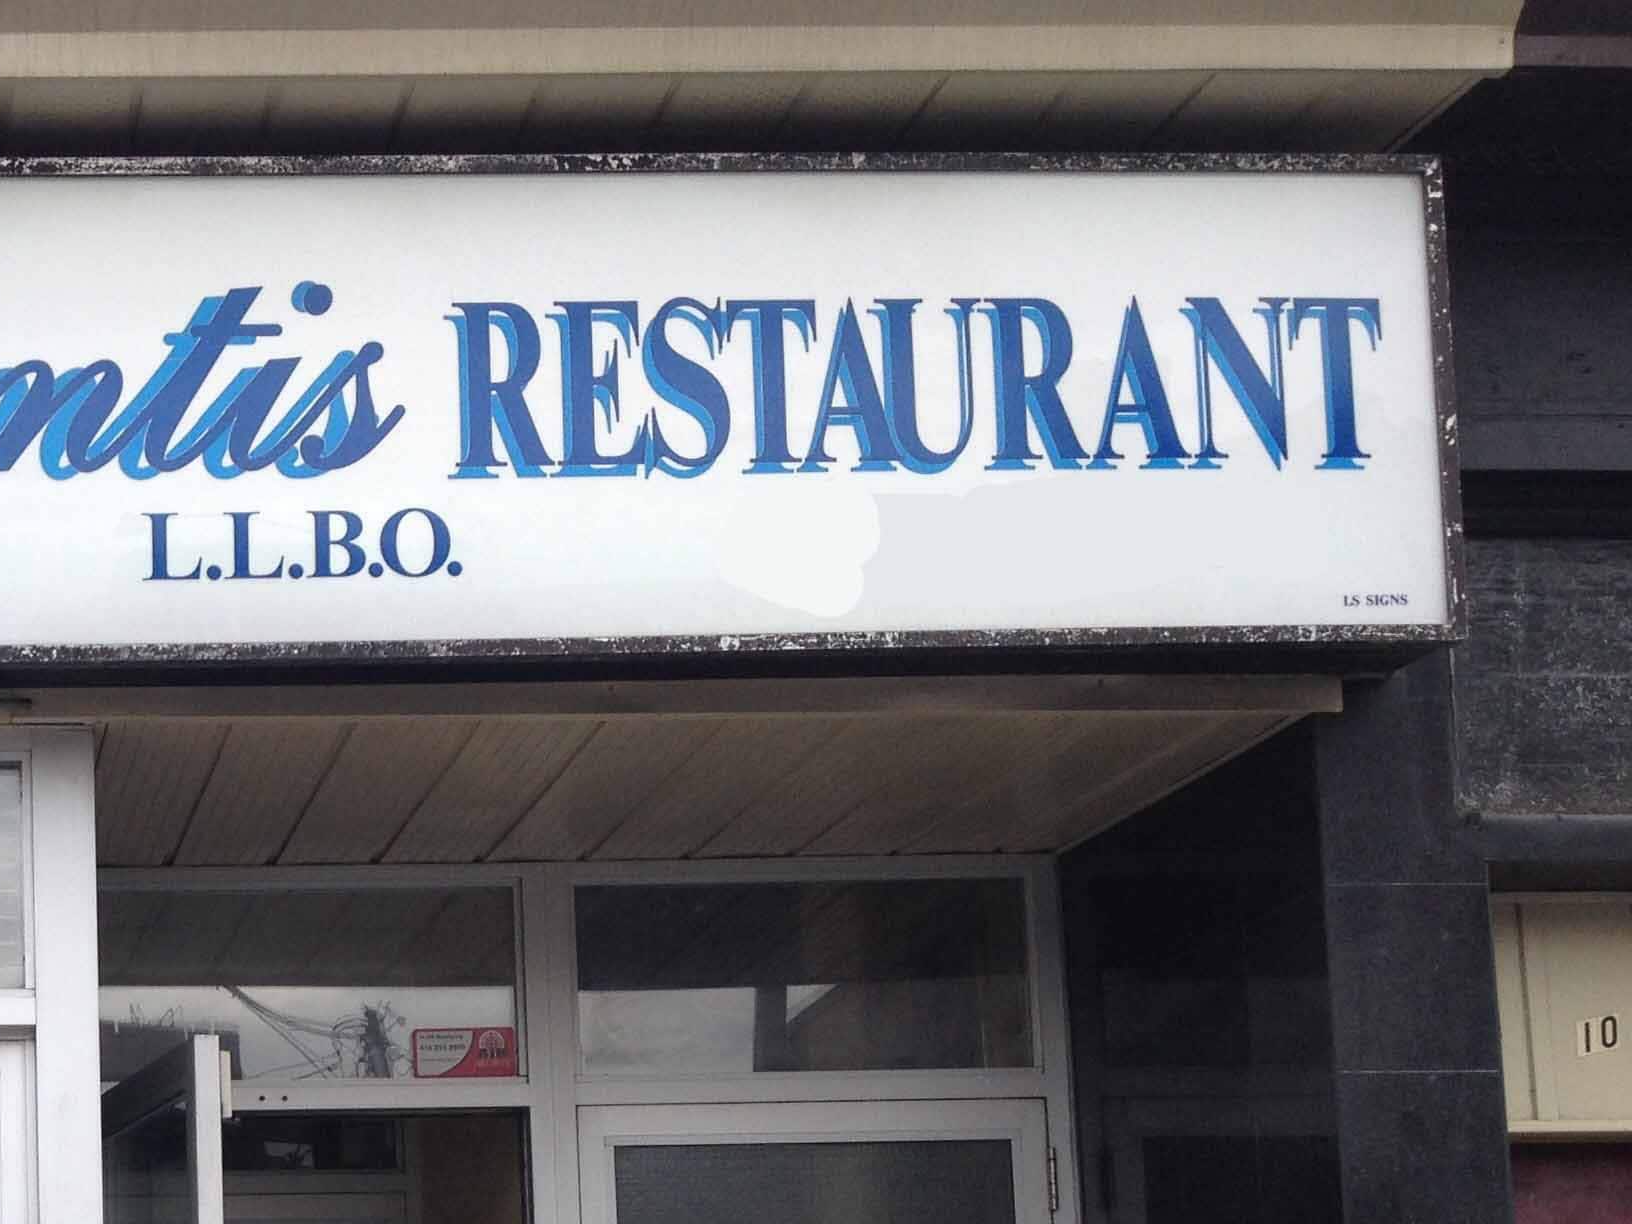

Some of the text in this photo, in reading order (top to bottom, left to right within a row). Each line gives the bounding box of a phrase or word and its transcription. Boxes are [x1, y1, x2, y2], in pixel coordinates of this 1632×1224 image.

[445, 295, 1381, 480] RESTAURANT
[141, 507, 462, 581] L.L.B.O.
[1343, 593, 1409, 607] LS SIGNS
